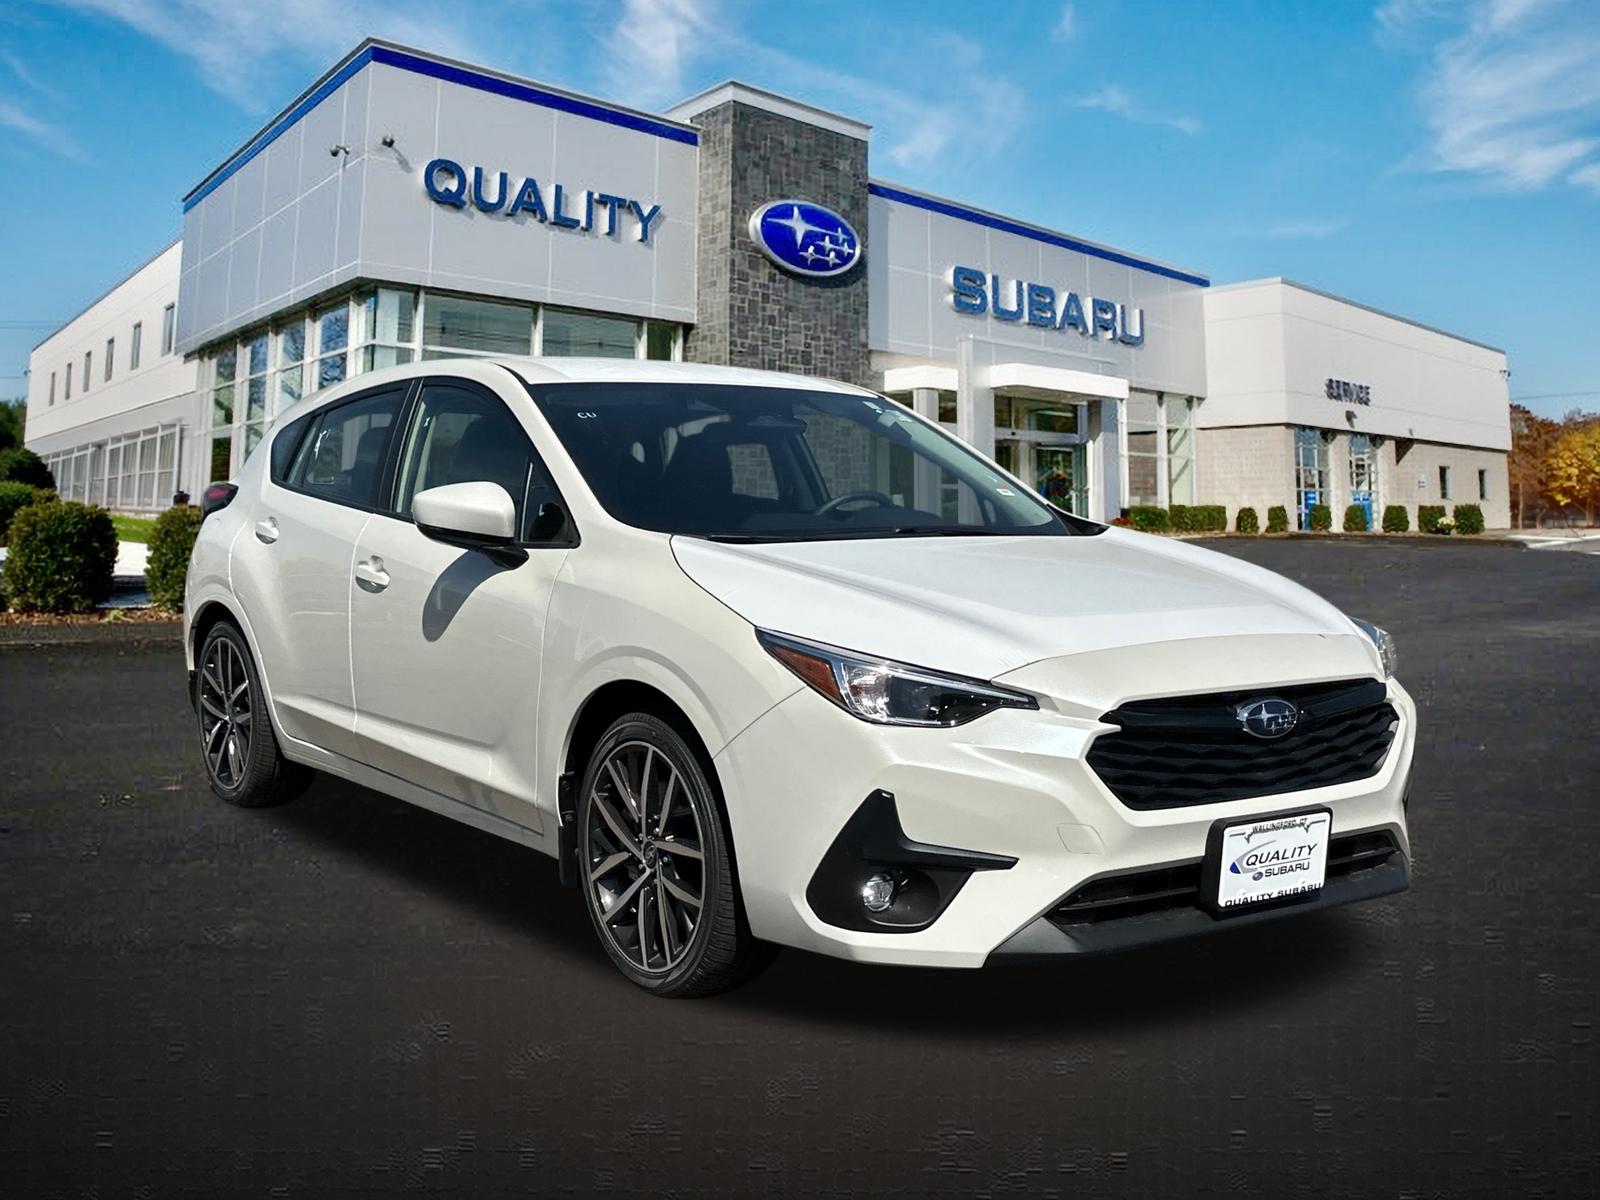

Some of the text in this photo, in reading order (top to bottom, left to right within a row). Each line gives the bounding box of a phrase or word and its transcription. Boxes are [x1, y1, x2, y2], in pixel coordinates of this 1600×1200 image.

[424, 158, 661, 242] QUALITY
[951, 264, 1145, 347] SUBARU
[1325, 378, 1371, 406] SERVICE
[1245, 843, 1317, 866] QUALITY
[1264, 861, 1310, 877] SUBARU
[1225, 882, 1321, 906] QUALITY SUBARU
